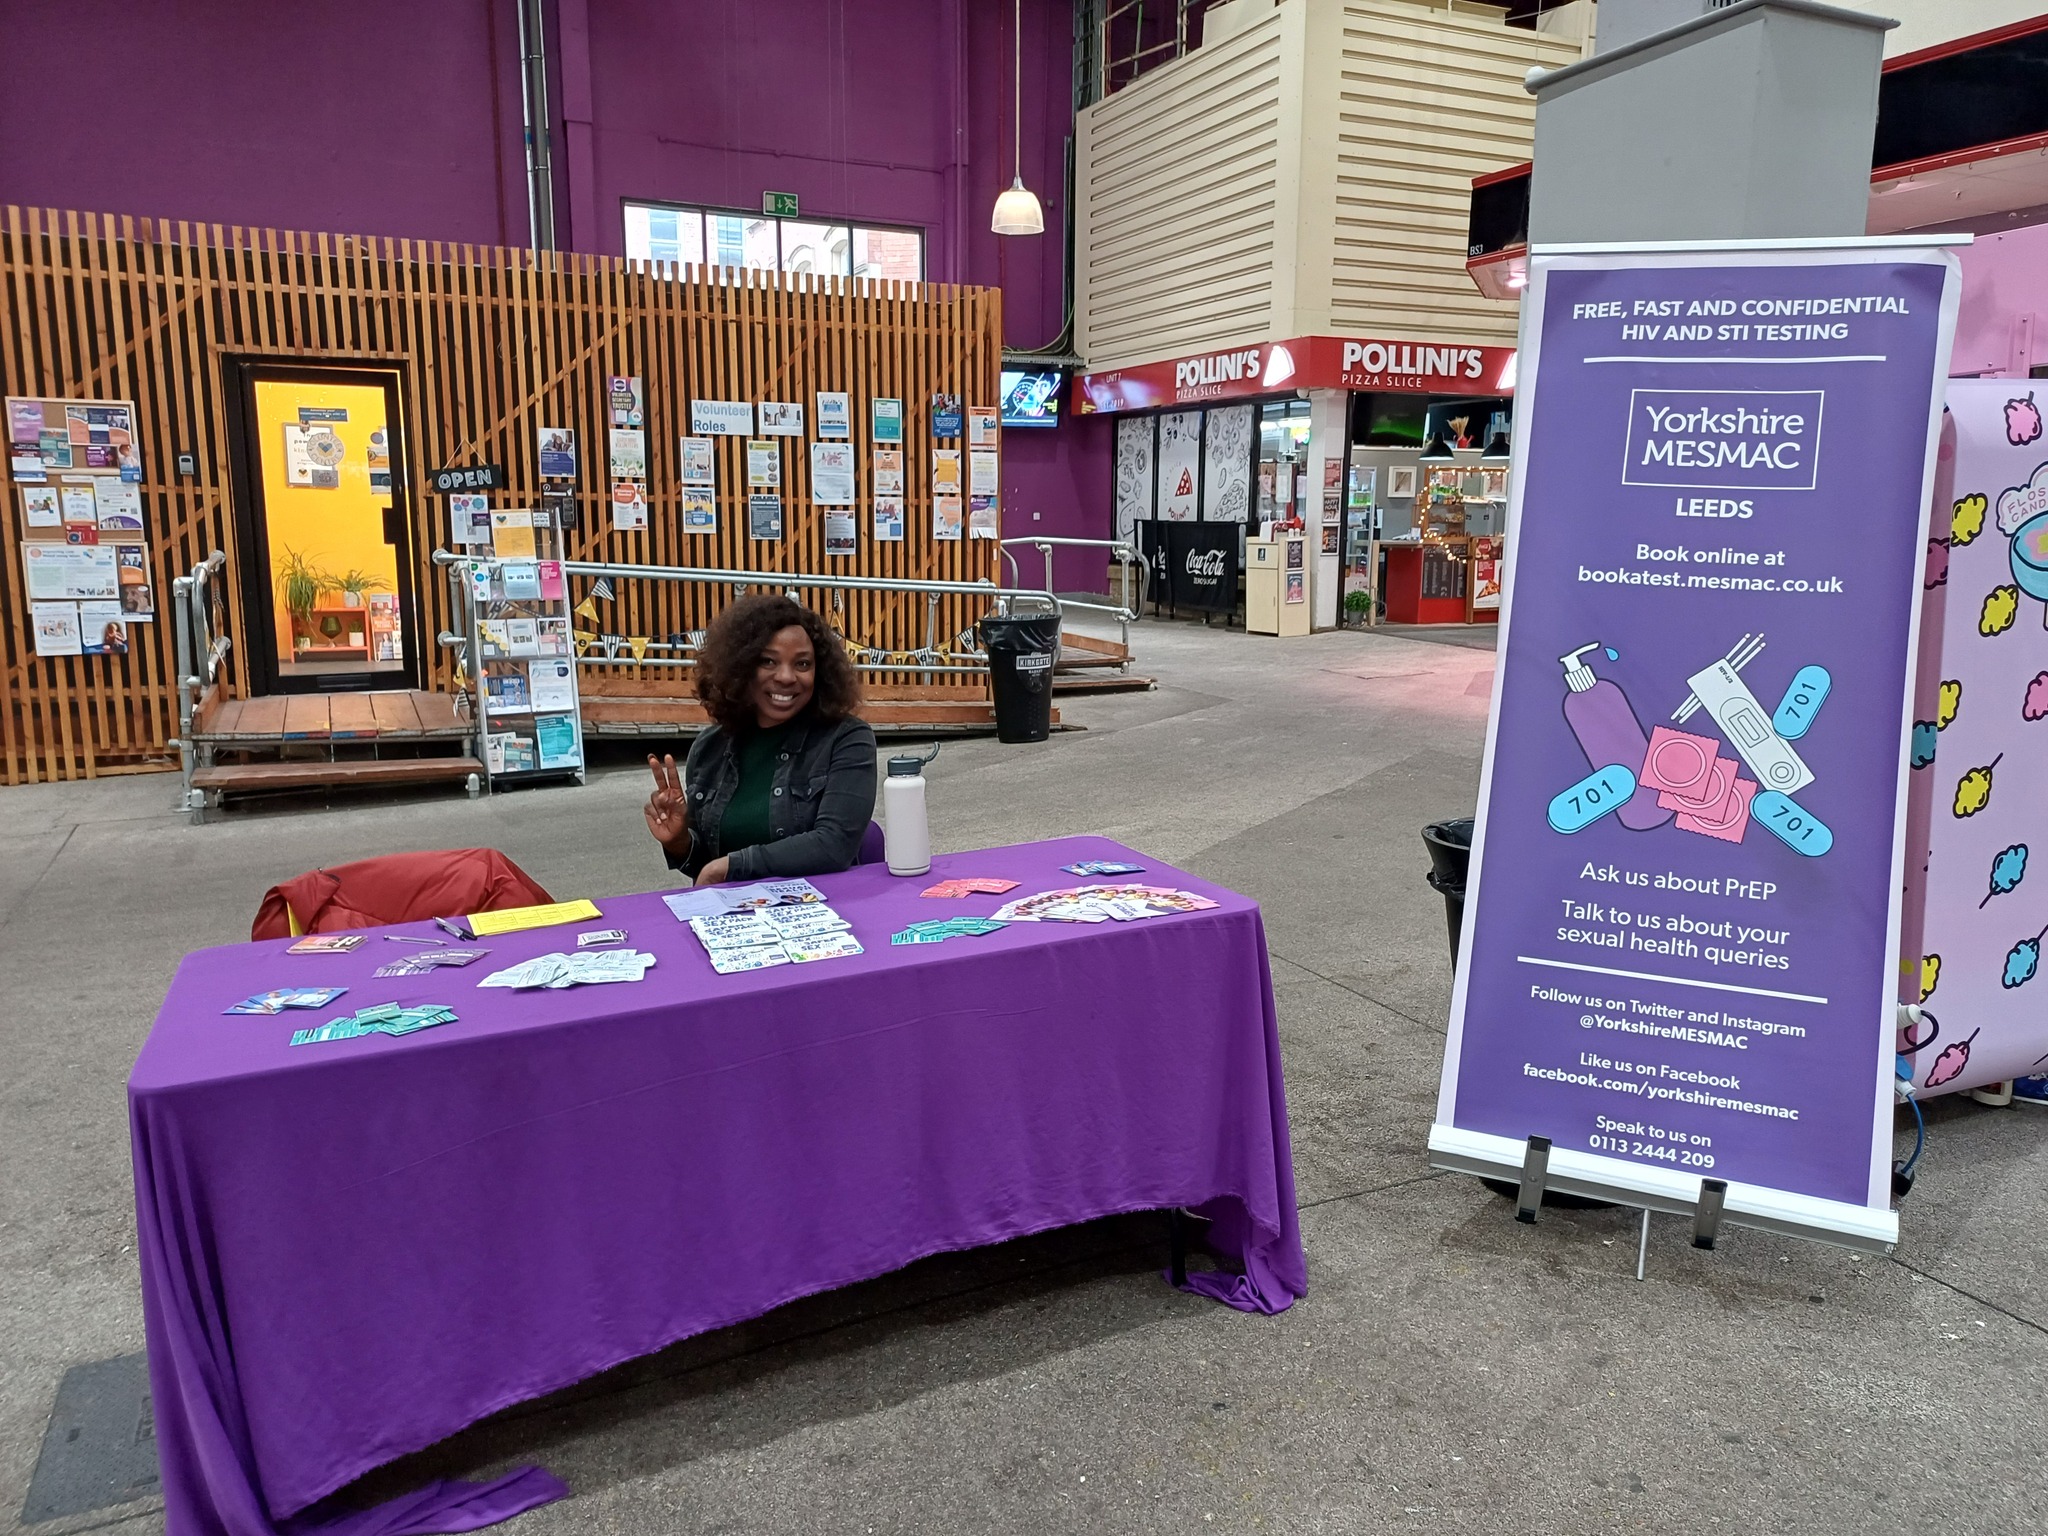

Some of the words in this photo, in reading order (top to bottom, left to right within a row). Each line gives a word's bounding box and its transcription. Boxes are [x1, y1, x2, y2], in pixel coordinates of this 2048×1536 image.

[1470, 244, 1483, 255] BS3
[1572, 300, 1628, 319] FREE,
[1633, 300, 1685, 317] FAST
[1686, 299, 1737, 316] AND
[1741, 296, 1910, 316] CONFIDENTIAL
[1621, 324, 1661, 341] HIV
[1662, 324, 1713, 341] AND
[1716, 324, 1750, 341] STI
[1753, 322, 1849, 341] TESTING
[1175, 350, 1260, 388] POLLINI'S
[1343, 342, 1482, 378] POLLINI'S
[1176, 388, 1198, 400] PIZZA
[1200, 385, 1222, 397] SLICE
[1342, 373, 1380, 386] PIZZA
[1386, 375, 1422, 388] SLICE
[694, 402, 750, 417] Volunteer
[1645, 405, 1805, 435] Yorkshire
[694, 419, 726, 432] Roles
[1641, 439, 1801, 469] MESMAC
[438, 469, 492, 489] OPEN
[1675, 497, 1754, 519] LEEDS
[2007, 487, 2046, 514] FLOS
[2011, 498, 2046, 523] CAND
[1636, 543, 1690, 562] Book
[1693, 547, 1760, 566] online
[1763, 550, 1786, 566] at
[1577, 565, 1844, 593] bookatest.mesmac.co.uk
[1020, 657, 1049, 667] KIRKGATE
[1785, 682, 1816, 719] 701
[1568, 779, 1615, 814] 701
[1772, 805, 1814, 841] 701
[1579, 861, 1620, 884] Ask
[1625, 871, 1649, 887] us
[1653, 871, 1721, 895] about
[1725, 877, 1777, 901] PrEP
[1561, 899, 1605, 922] Talk
[1608, 907, 1632, 925] to
[1637, 913, 1661, 929] us
[1665, 913, 1733, 939] about
[1736, 926, 1791, 945] your
[1556, 927, 1625, 949] sexual
[1630, 931, 1699, 959] health
[1704, 946, 1790, 970] queries
[1530, 985, 1583, 1005] Follow
[1584, 996, 1603, 1008] us
[1605, 999, 1626, 1012] on
[1629, 999, 1686, 1020] Twitter
[1687, 1011, 1719, 1025] and
[1722, 1012, 1806, 1038] Instagram
[1579, 1014, 1749, 1050] @YorkshireMESMAC
[1580, 1051, 1612, 1069] Like
[1614, 1060, 1633, 1073] us
[1635, 1064, 1657, 1077] on
[1660, 1064, 1741, 1090] Facebook
[1523, 1062, 1799, 1121] facebook.com/yorkshiremesmac
[1595, 1115, 1646, 1136] Speak
[1648, 1125, 1666, 1139] to
[1668, 1130, 1687, 1143] us
[1690, 1134, 1712, 1148] on
[1589, 1134, 1628, 1153] 0113
[1631, 1141, 1678, 1162] 2444
[1680, 1150, 1715, 1169] 209
